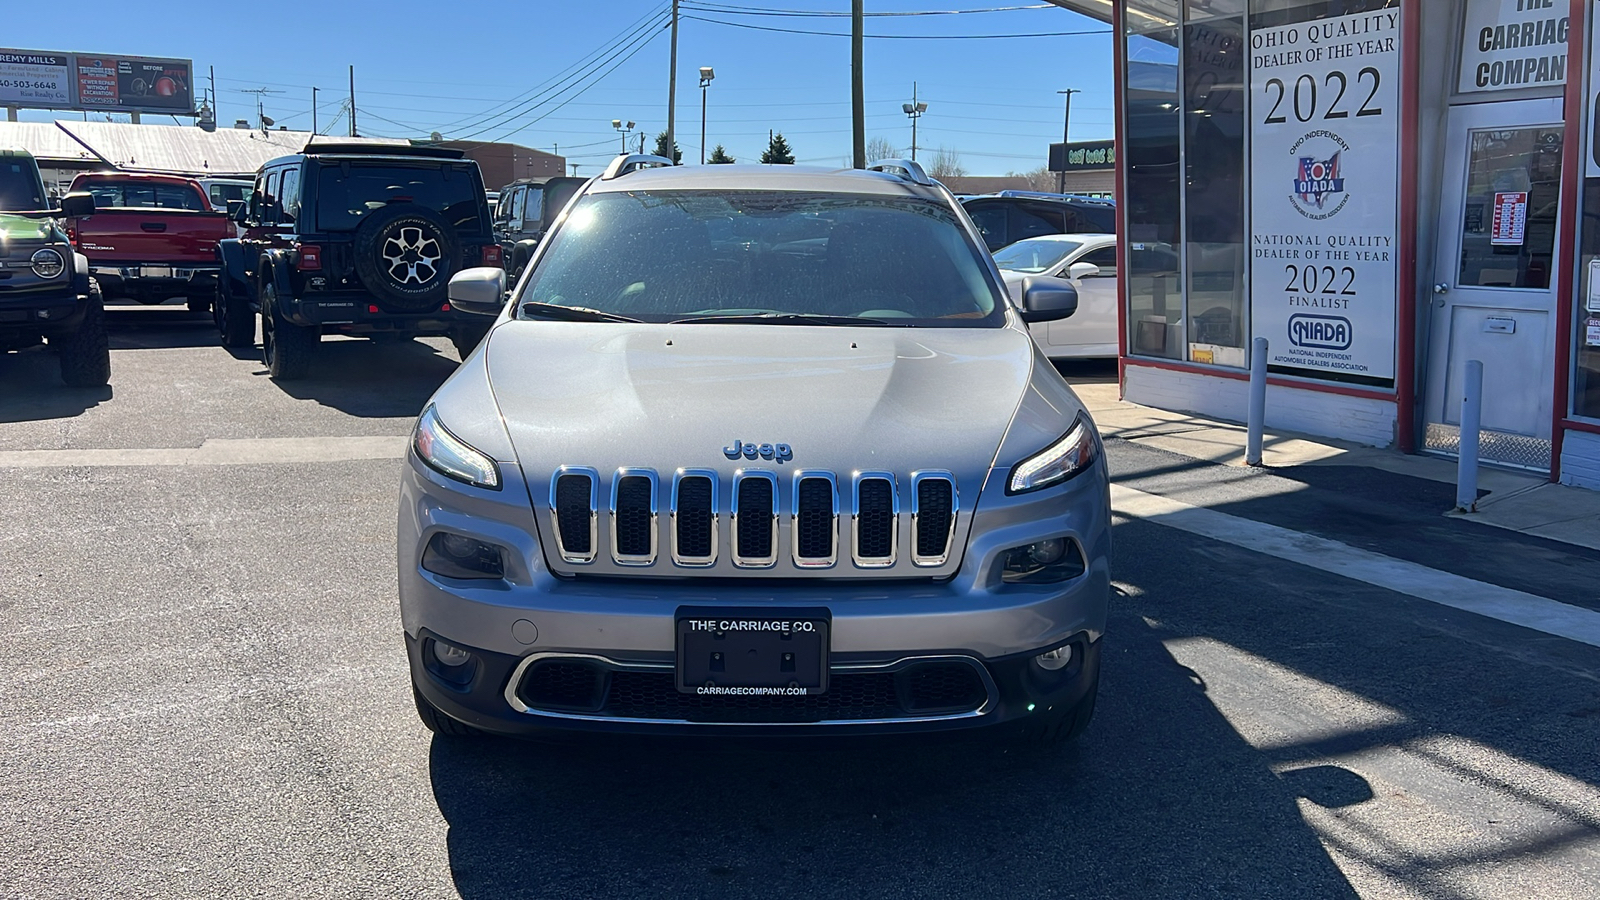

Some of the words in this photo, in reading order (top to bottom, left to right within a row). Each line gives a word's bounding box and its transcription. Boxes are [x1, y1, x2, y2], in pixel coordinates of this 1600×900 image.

[1252, 29, 1299, 49] OHIO
[1308, 12, 1399, 44] QUALITY
[28, 56, 56, 64] MILLS
[1254, 49, 1302, 69] DEALER
[1306, 47, 1323, 63] OF
[1327, 43, 1353, 60] THE
[1357, 37, 1395, 56] YEAR
[34, 91, 54, 99] Realty
[1263, 66, 1382, 125] 2022
[1289, 137, 1305, 155] OHIO
[1304, 129, 1350, 152] INDEPENDENT
[1299, 180, 1335, 193] OIADA
[1288, 195, 1309, 219] AUTOMOBILE
[1327, 193, 1350, 218] ASSOCIATION
[1253, 235, 1322, 246] NATIONAL
[1327, 235, 1392, 247] QUALITY
[1255, 249, 1300, 260] DEALER
[1304, 250, 1320, 260] OF
[1325, 250, 1350, 261] THE
[1355, 251, 1390, 262] YEAR
[1284, 264, 1357, 296] 2022
[1289, 296, 1350, 310] FINALIST
[1293, 320, 1346, 343] NIADA
[1288, 348, 1314, 357] NATIONAL
[1315, 351, 1352, 361] INDEPENDENT
[1274, 355, 1307, 364] AUTOMOBILE
[1307, 359, 1330, 368] DEALERS
[1330, 362, 1368, 371] ASSOCIATION
[722, 439, 794, 464] Jeep
[689, 620, 717, 631] THE
[720, 620, 790, 632] CARRIAGE
[792, 621, 816, 633] CO.
[697, 686, 807, 696] CARRIAGECOMPANY.COM
